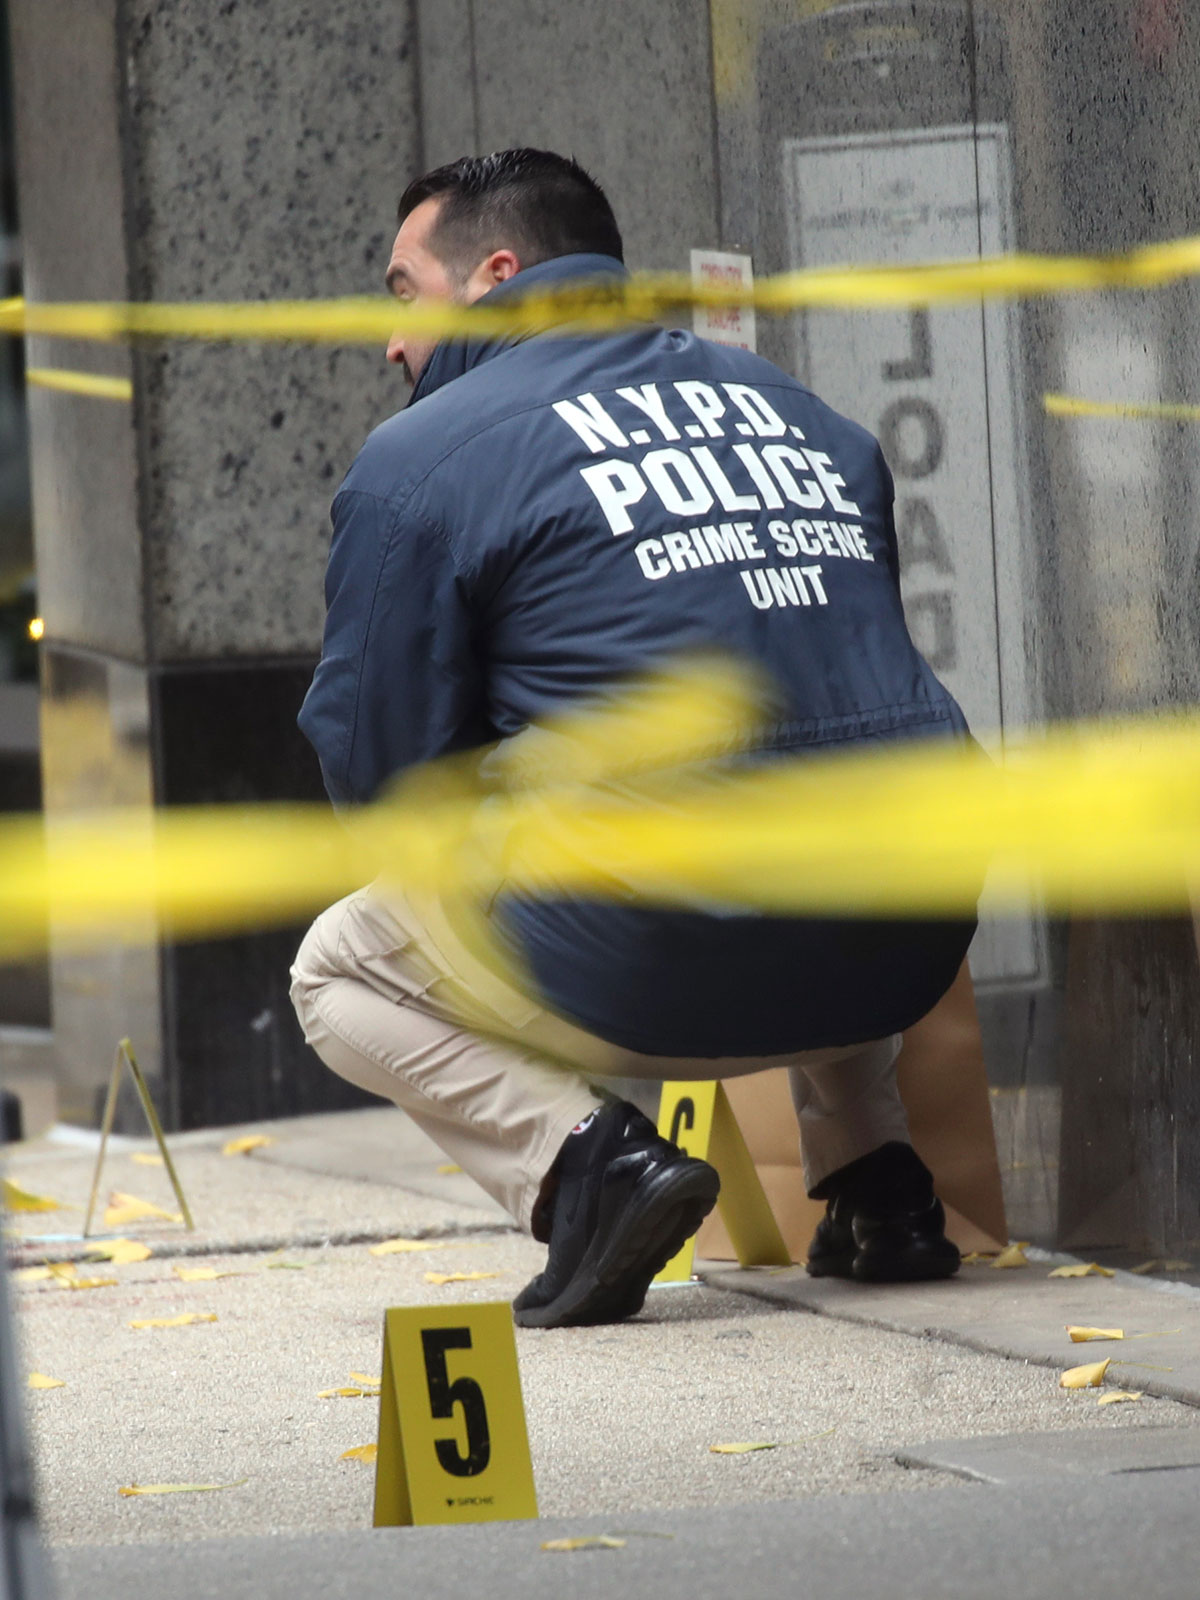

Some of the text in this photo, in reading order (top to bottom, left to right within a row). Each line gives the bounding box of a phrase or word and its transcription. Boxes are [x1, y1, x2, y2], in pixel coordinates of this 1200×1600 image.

[551, 380, 806, 454] N.Y.P.D.
[579, 442, 862, 536] POLICE
[634, 518, 875, 580] CRIME SCENE
[739, 564, 829, 610] UNIT
[421, 1327, 490, 1477] 5
